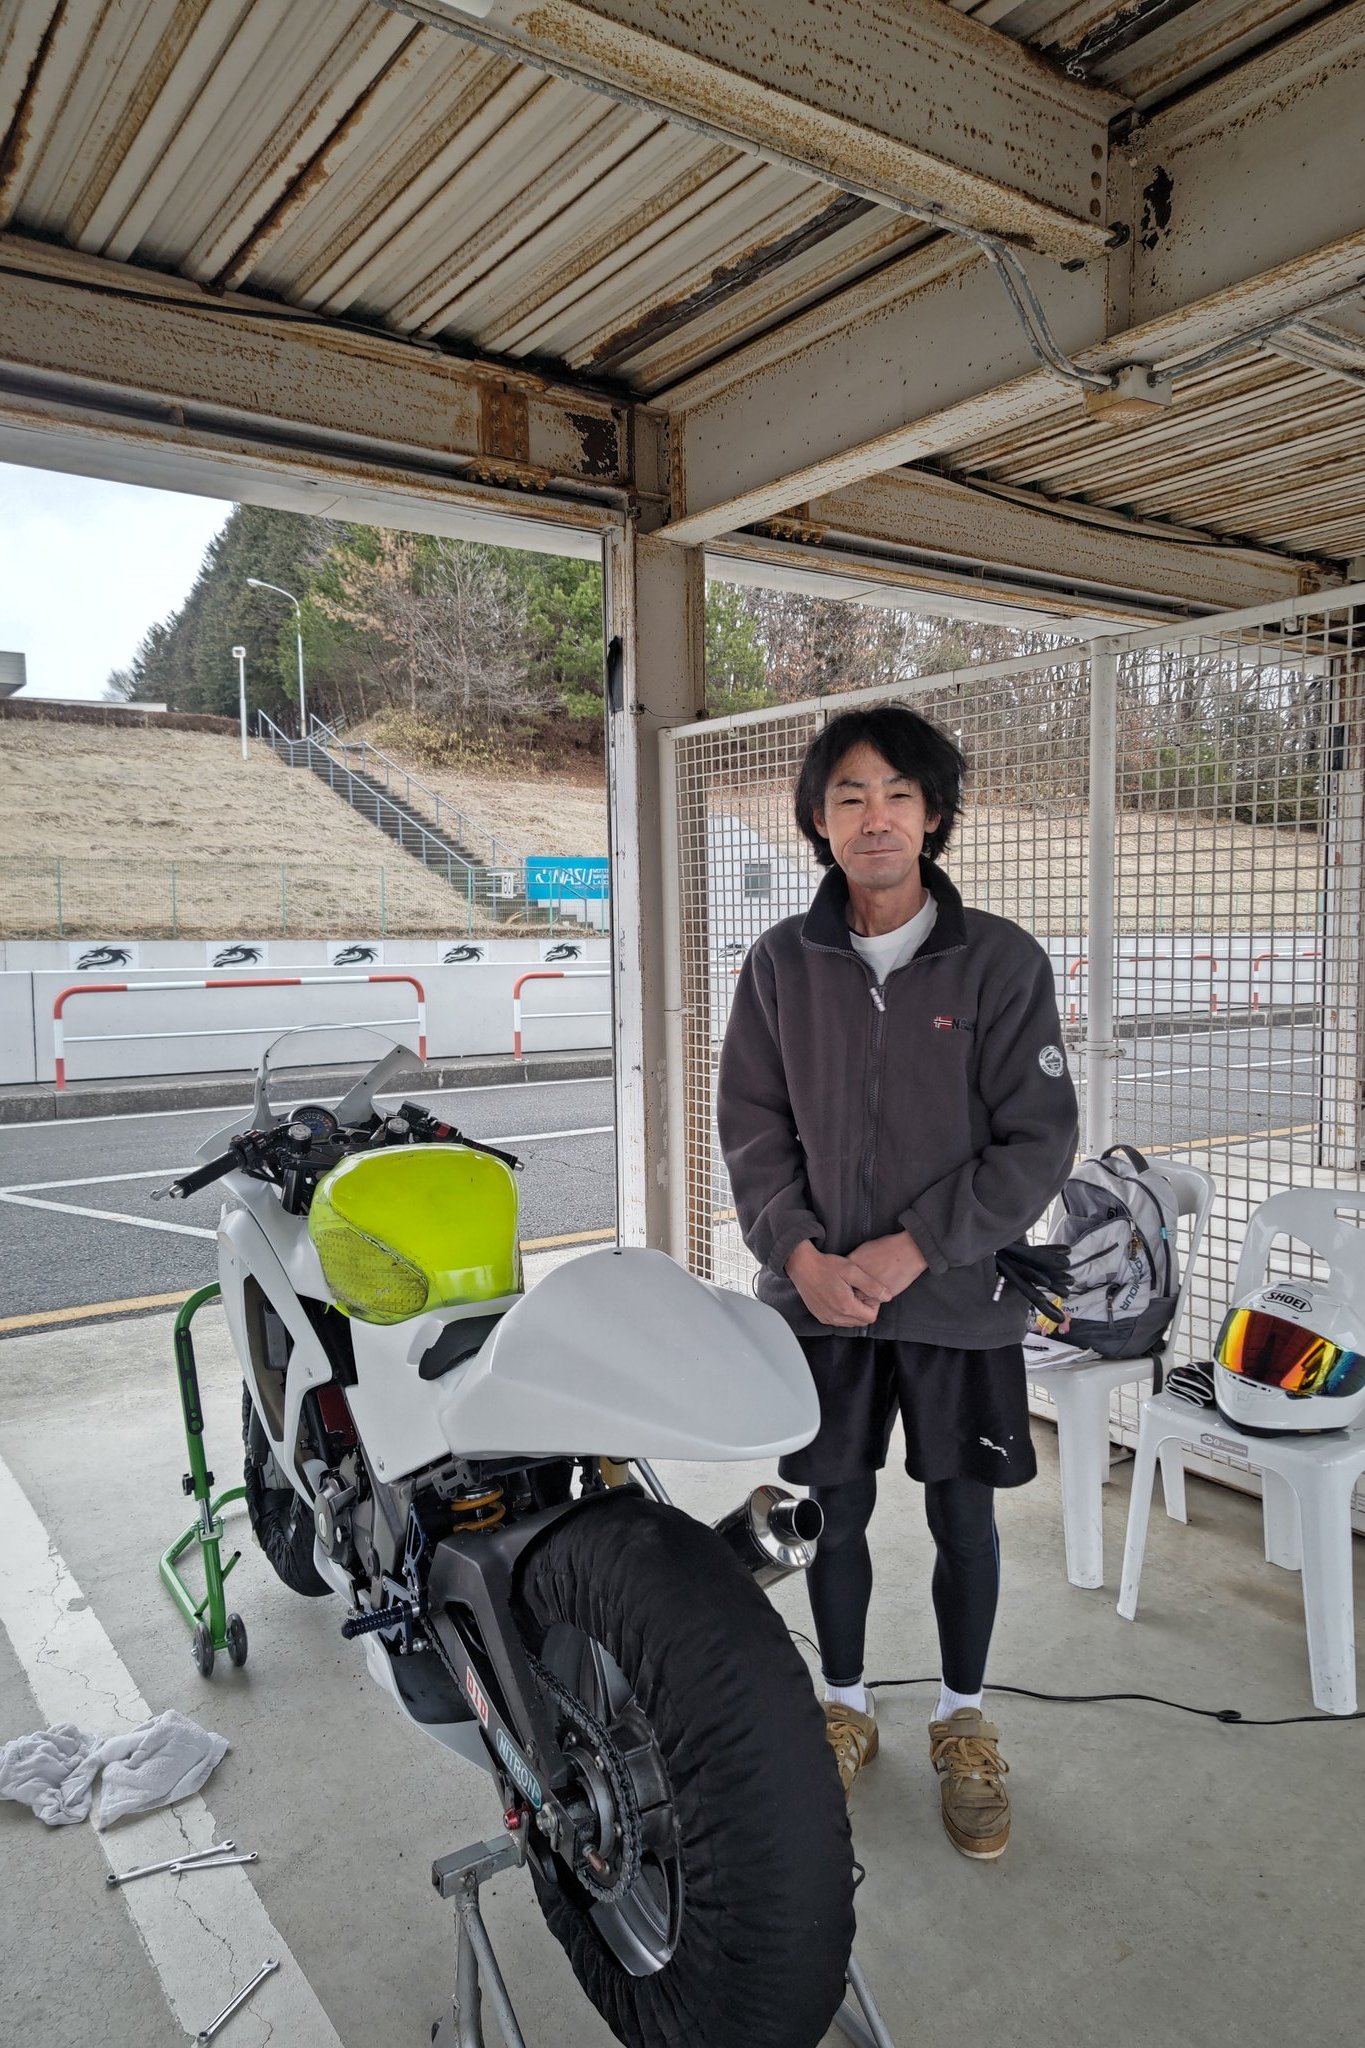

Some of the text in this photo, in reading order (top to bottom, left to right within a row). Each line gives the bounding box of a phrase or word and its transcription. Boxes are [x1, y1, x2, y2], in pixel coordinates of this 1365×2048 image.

[553, 868, 593, 885] NASU
[1267, 1291, 1307, 1310] SHOEI
[499, 1734, 538, 1798] NITRON
